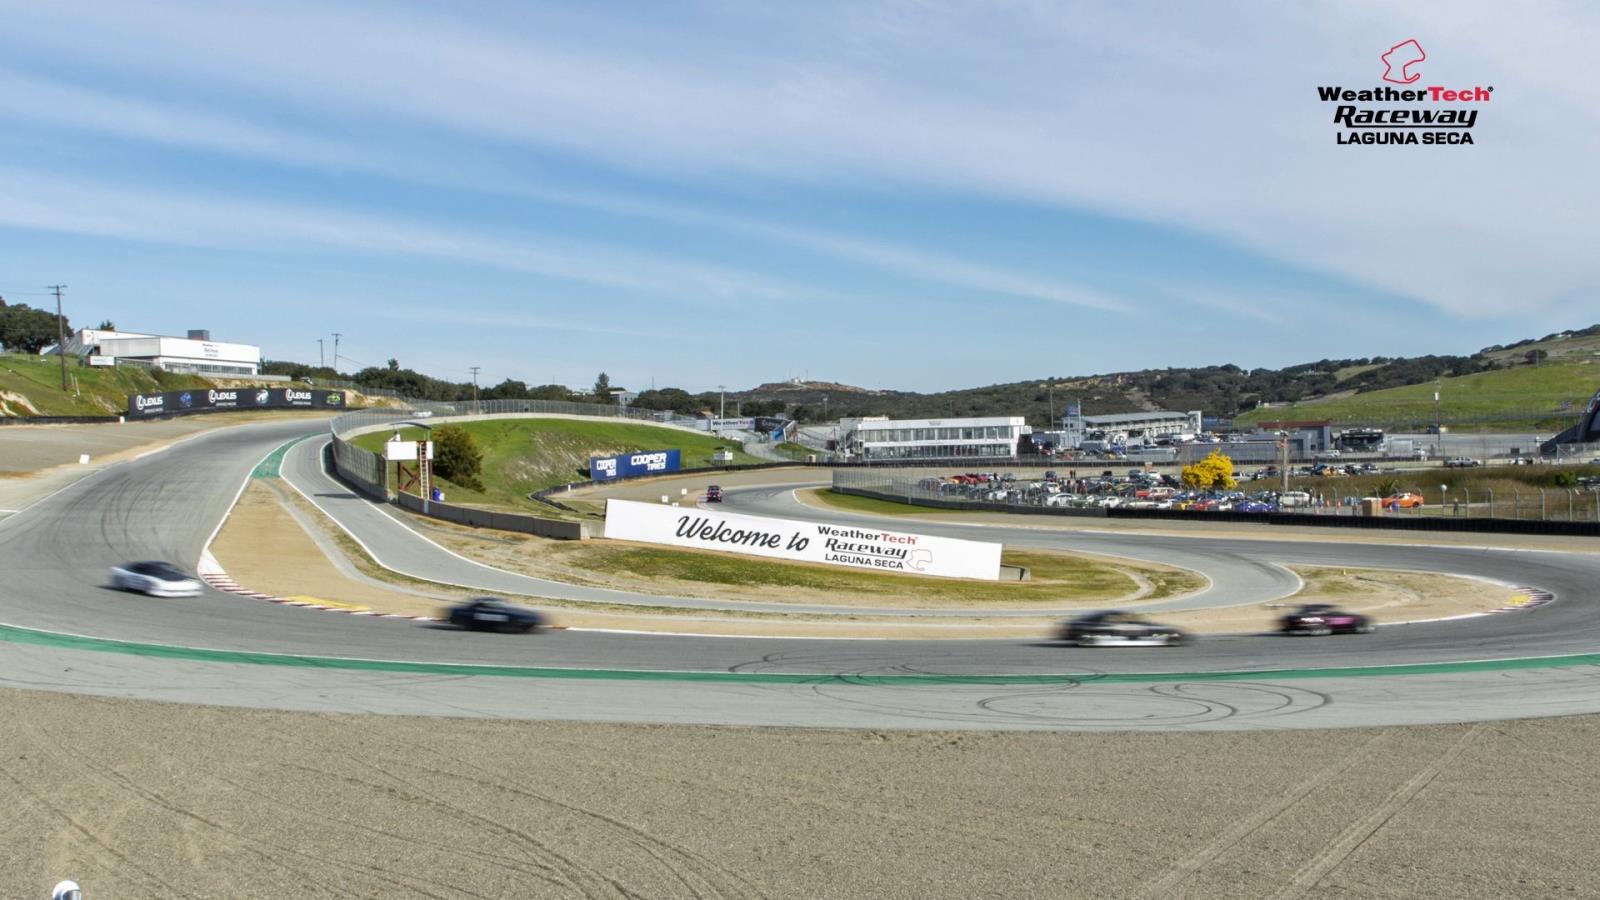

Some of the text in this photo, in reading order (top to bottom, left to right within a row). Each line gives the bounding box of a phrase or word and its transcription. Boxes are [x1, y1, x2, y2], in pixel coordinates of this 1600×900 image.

[631, 453, 667, 466] COOPER
[647, 463, 666, 471] TIRES
[676, 515, 810, 551] Welcome to
[824, 537, 908, 560] Raceway
[824, 553, 904, 569] LAGUNA SECA
